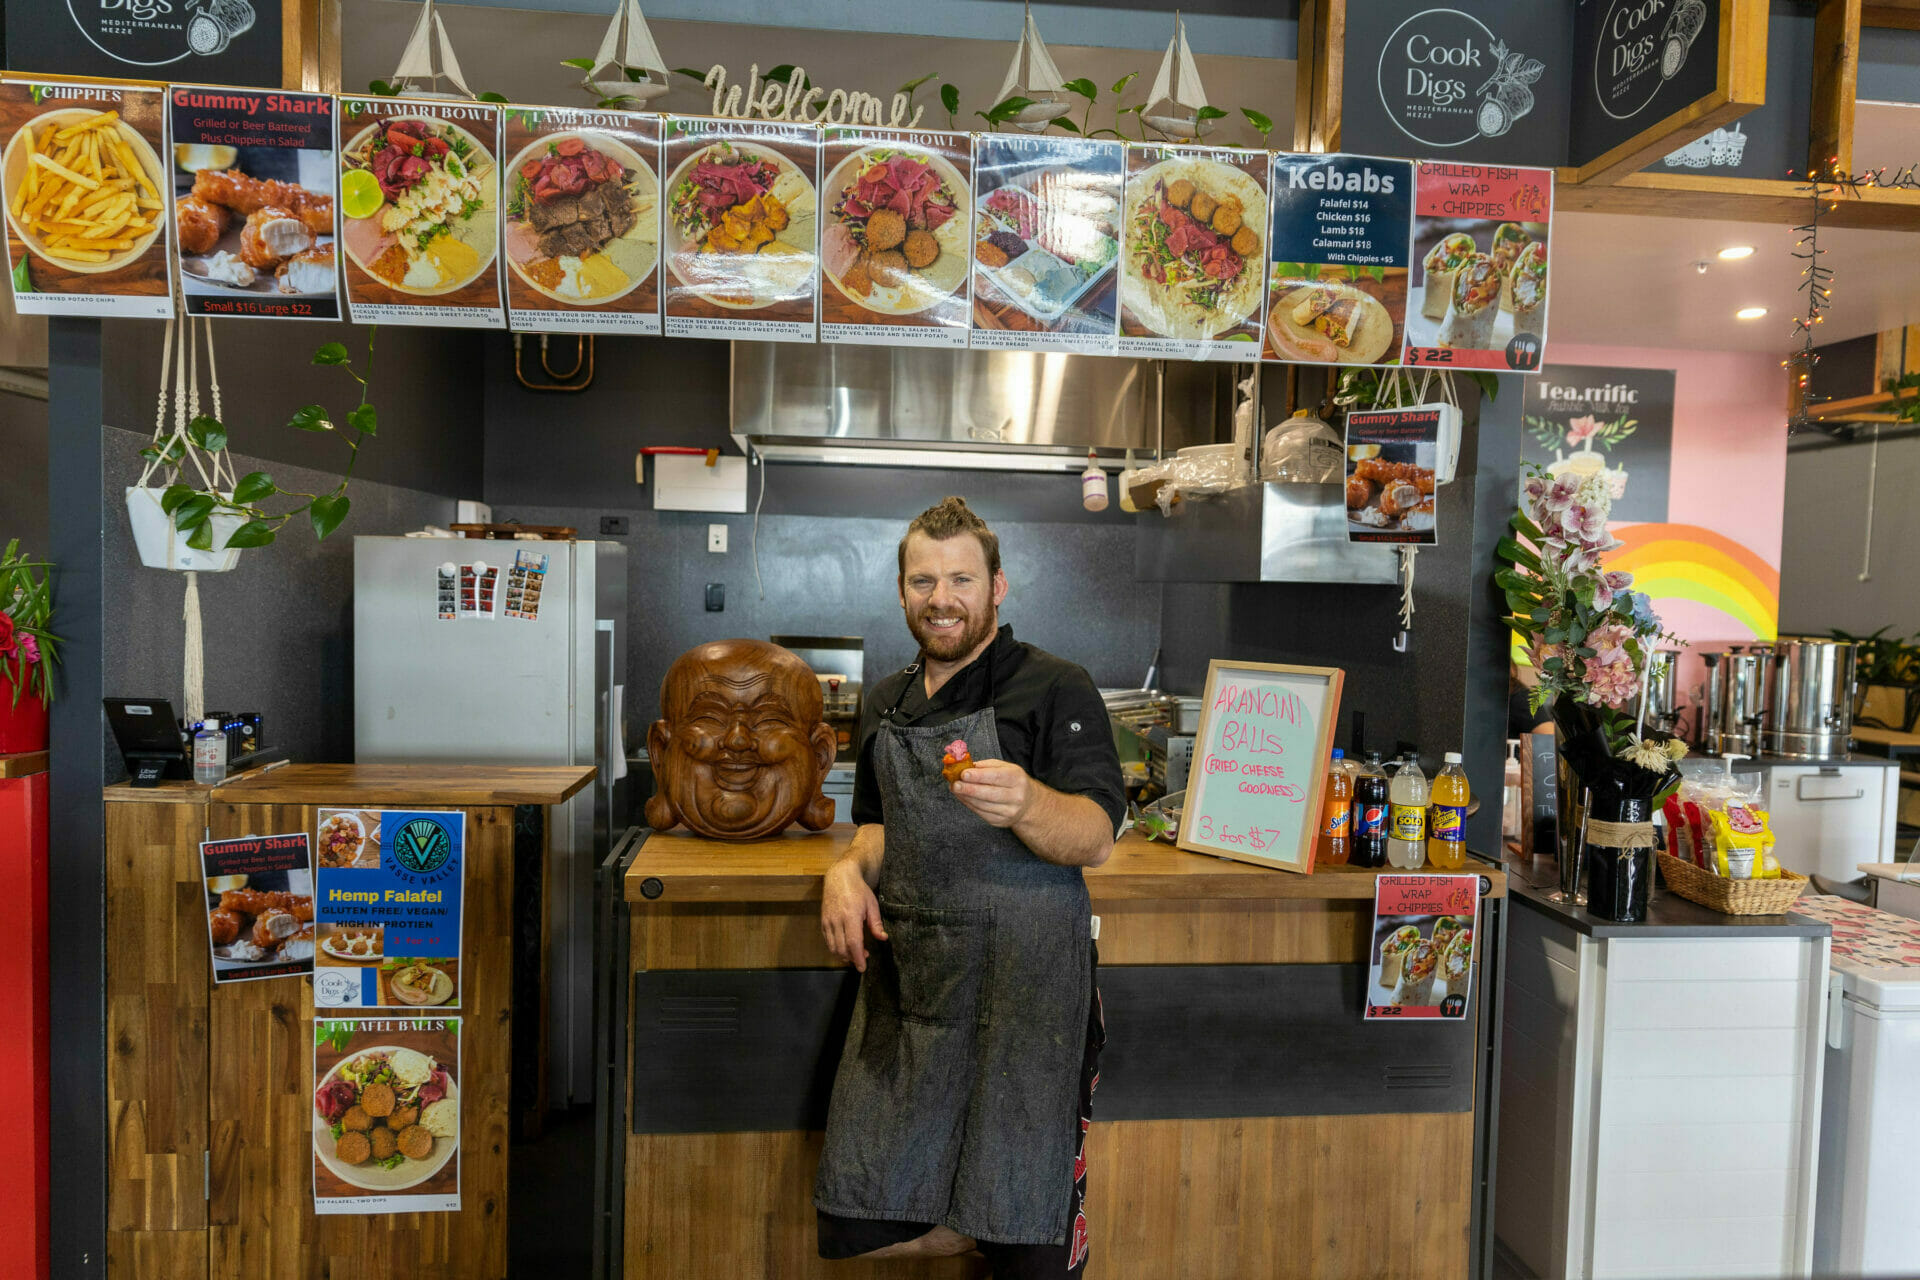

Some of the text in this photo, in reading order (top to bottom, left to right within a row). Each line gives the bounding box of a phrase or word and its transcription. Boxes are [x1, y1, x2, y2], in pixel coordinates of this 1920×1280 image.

[101, 19, 182, 30] MEDITERRANEAN
[101, 27, 132, 35] MEZZE
[1407, 35, 1481, 66] Cook
[1613, 35, 1654, 77] Digs
[1407, 68, 1465, 105] Digs
[41, 87, 121, 101] CHIPPIES
[704, 63, 924, 128] Welcome
[174, 90, 330, 114] Gummy Shark
[350, 102, 492, 121] CALAMARI BOWL
[1407, 105, 1473, 114] MEDITERRANEAN
[193, 118, 226, 129] Grilled
[242, 121, 265, 130] Beer
[268, 122, 311, 133] Battered
[532, 111, 632, 128] LAMB BOWL
[676, 120, 802, 136] CHICKEN BOWL
[201, 134, 221, 143] Plus
[225, 134, 266, 146] Chippies
[279, 138, 304, 146] Salad
[910, 134, 957, 147] BOWL
[1210, 152, 1254, 164] WRAP
[1420, 164, 1518, 180] GRILLED FISH
[1289, 166, 1394, 194] Kebabs
[1448, 183, 1489, 197] WRAP
[1320, 199, 1368, 209] Falafel $14
[1443, 202, 1504, 216] CHIPPIES
[1316, 212, 1370, 222] Chicken $16
[1322, 226, 1364, 235] Lamb $18
[1313, 239, 1371, 249] Calamari $18
[1328, 253, 1345, 261] With
[1347, 254, 1379, 263] Chippies
[204, 301, 311, 316] Small $16 Large $22
[1425, 350, 1453, 362] 22
[1537, 382, 1639, 404] Tea.rrific
[1350, 411, 1438, 425] Gummy Shark
[1214, 685, 1301, 728] ARANCINI
[1222, 720, 1284, 754] BALLS
[1205, 753, 1284, 778] (FRIED CHEESE
[1239, 781, 1305, 803] GOODNESS)
[1199, 816, 1214, 839] 3
[1399, 817, 1422, 825] SOLO
[204, 835, 306, 855] Gummy Shark
[385, 857, 458, 885] VASSE VALLEY
[1381, 877, 1453, 886] GRILLED FISH
[329, 890, 442, 904] Hemp Falafel
[1401, 890, 1432, 899] WRAP
[1397, 904, 1443, 912] CHIPPIES
[331, 1021, 445, 1032] FALAFEL BALLS
